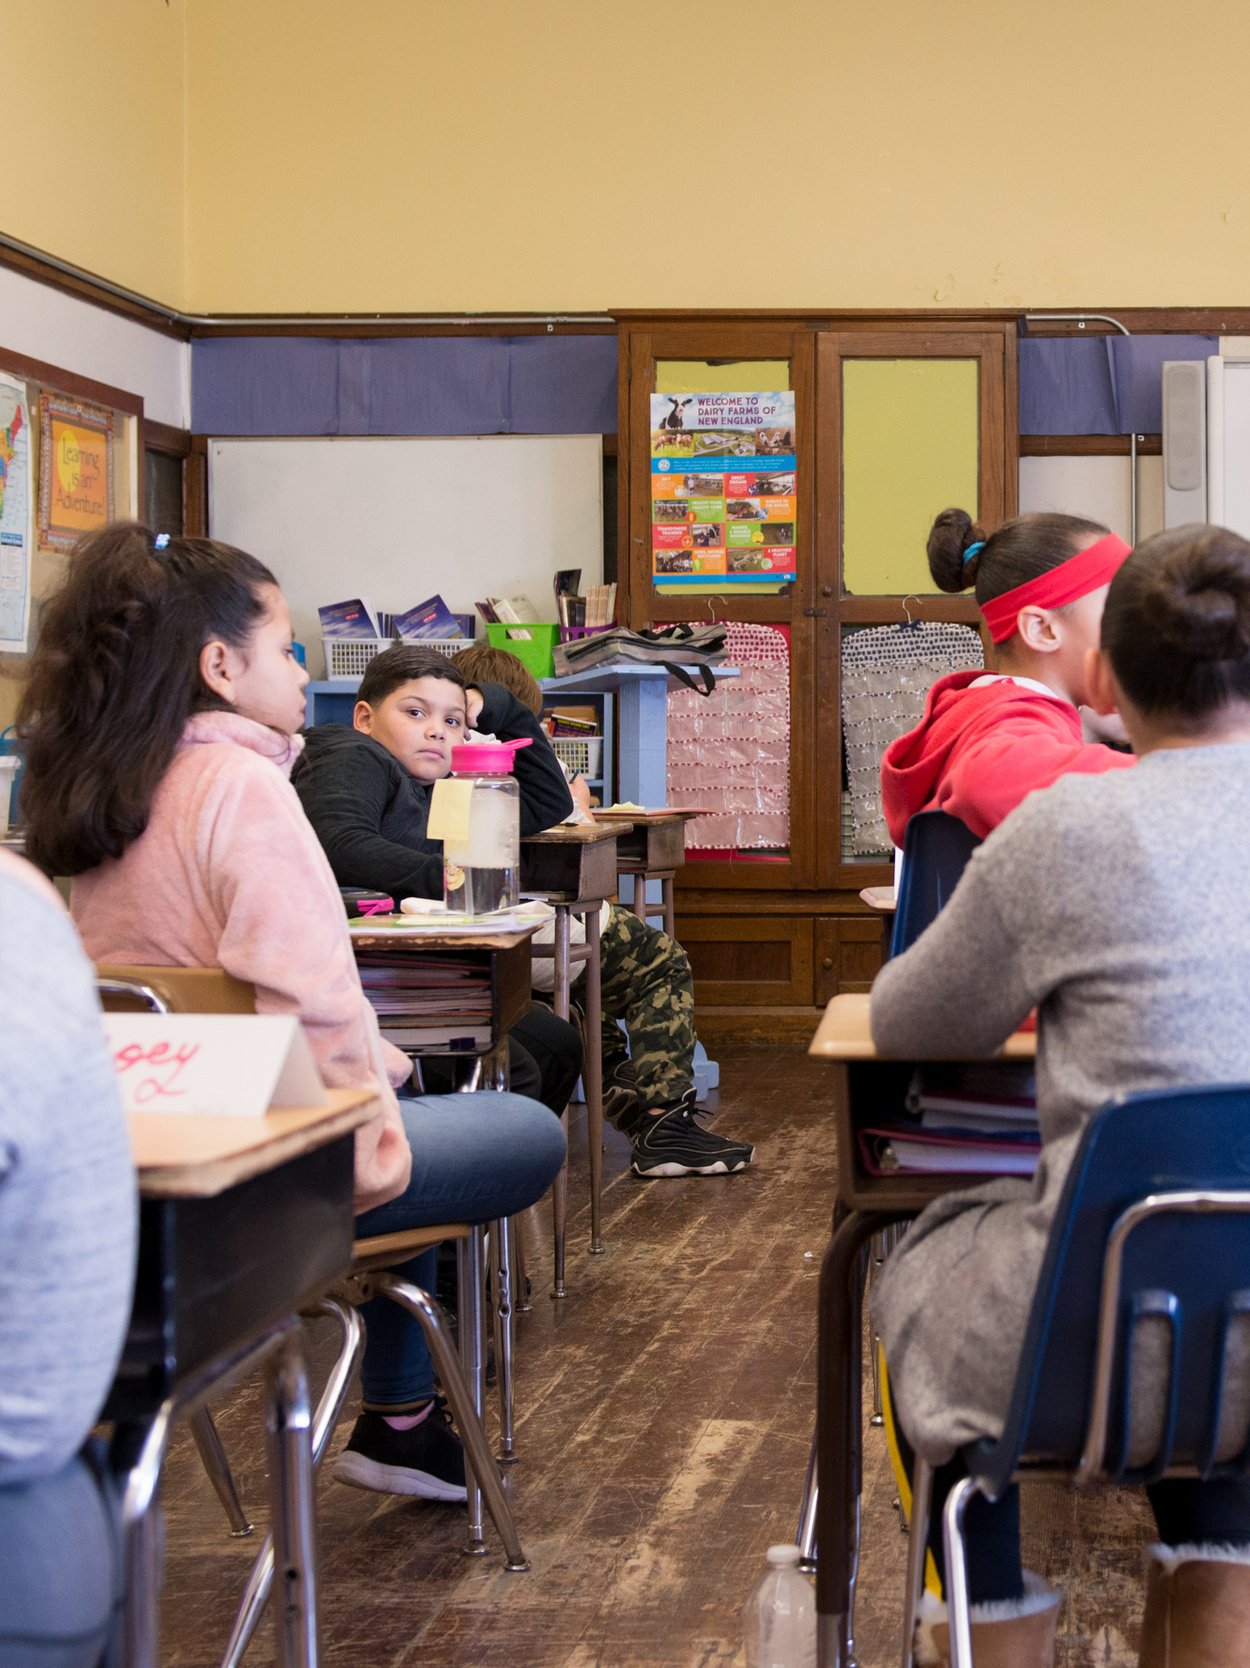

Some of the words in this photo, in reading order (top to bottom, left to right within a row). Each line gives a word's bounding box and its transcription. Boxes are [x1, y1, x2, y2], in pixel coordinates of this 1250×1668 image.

[697, 397, 743, 406] WELCOME
[746, 397, 759, 406] TO
[698, 406, 726, 416] DAIRY
[728, 406, 760, 415] FARMS
[762, 406, 777, 415] OF
[698, 417, 719, 426] NEW
[721, 416, 764, 425] ENGLAND
[62, 437, 101, 481] Learning
[71, 465, 79, 487] is
[80, 473, 92, 489] an
[56, 481, 105, 517] Adventure!
